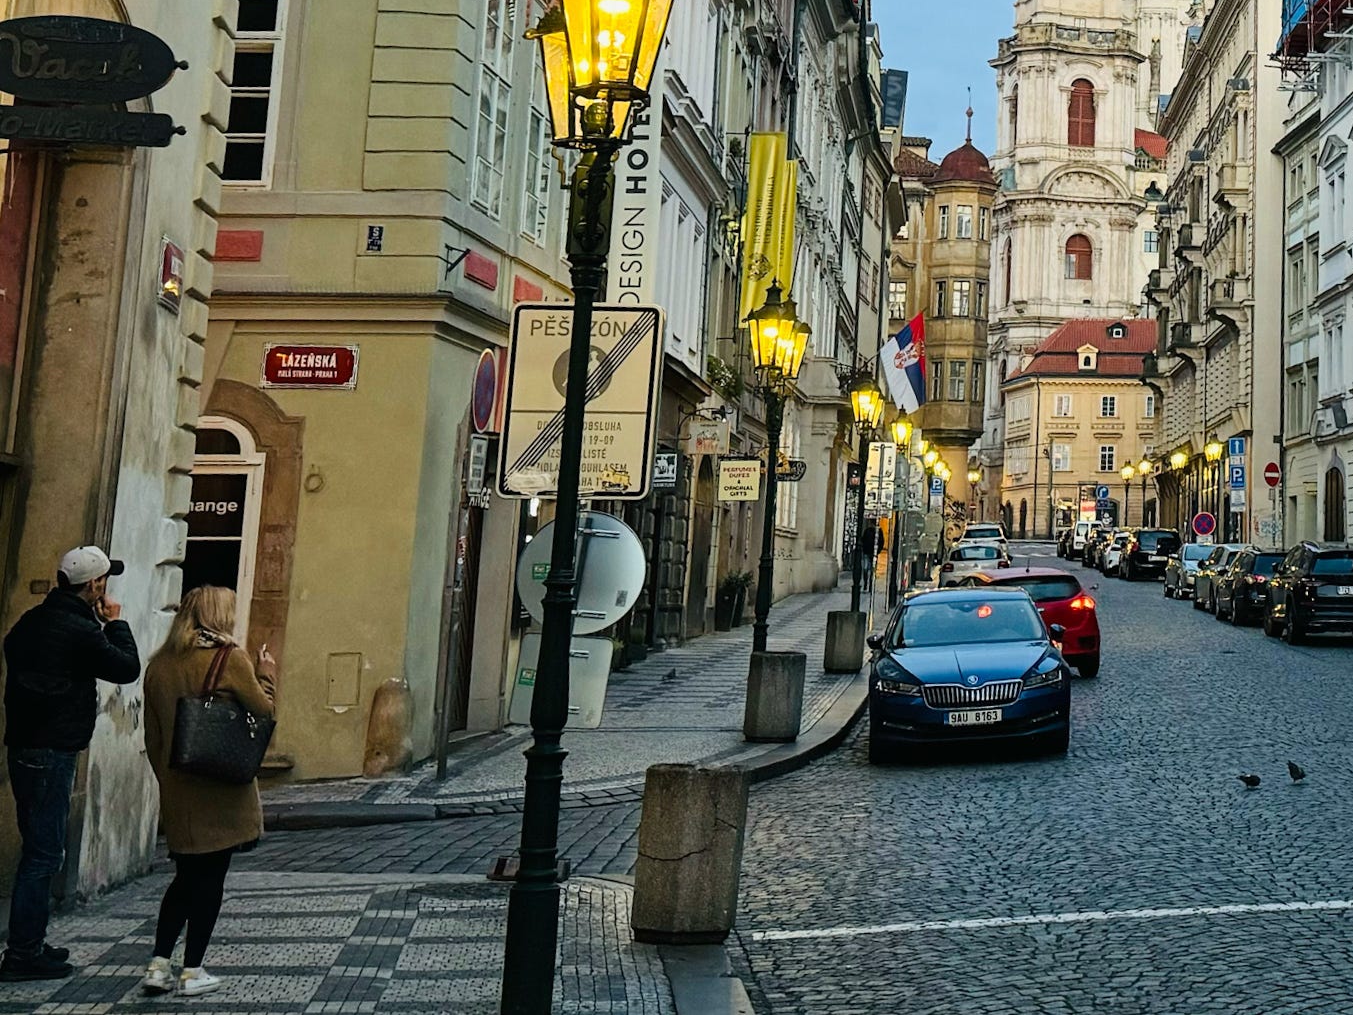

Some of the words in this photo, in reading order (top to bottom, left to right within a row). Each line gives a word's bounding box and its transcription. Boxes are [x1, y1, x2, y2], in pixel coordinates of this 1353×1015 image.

[530, 315, 570, 337] PĚŠ
[589, 316, 628, 338] ZÓN
[281, 352, 337, 368] LÁZEŇSKÁ
[277, 369, 292, 378] MALÁ
[292, 370, 312, 378] STRANA
[315, 370, 333, 378] PRAHA
[589, 435, 615, 445] 19-09
[581, 463, 628, 473] OUHLASEM
[1232, 468, 1243, 482] P
[951, 712, 969, 723] 9AU
